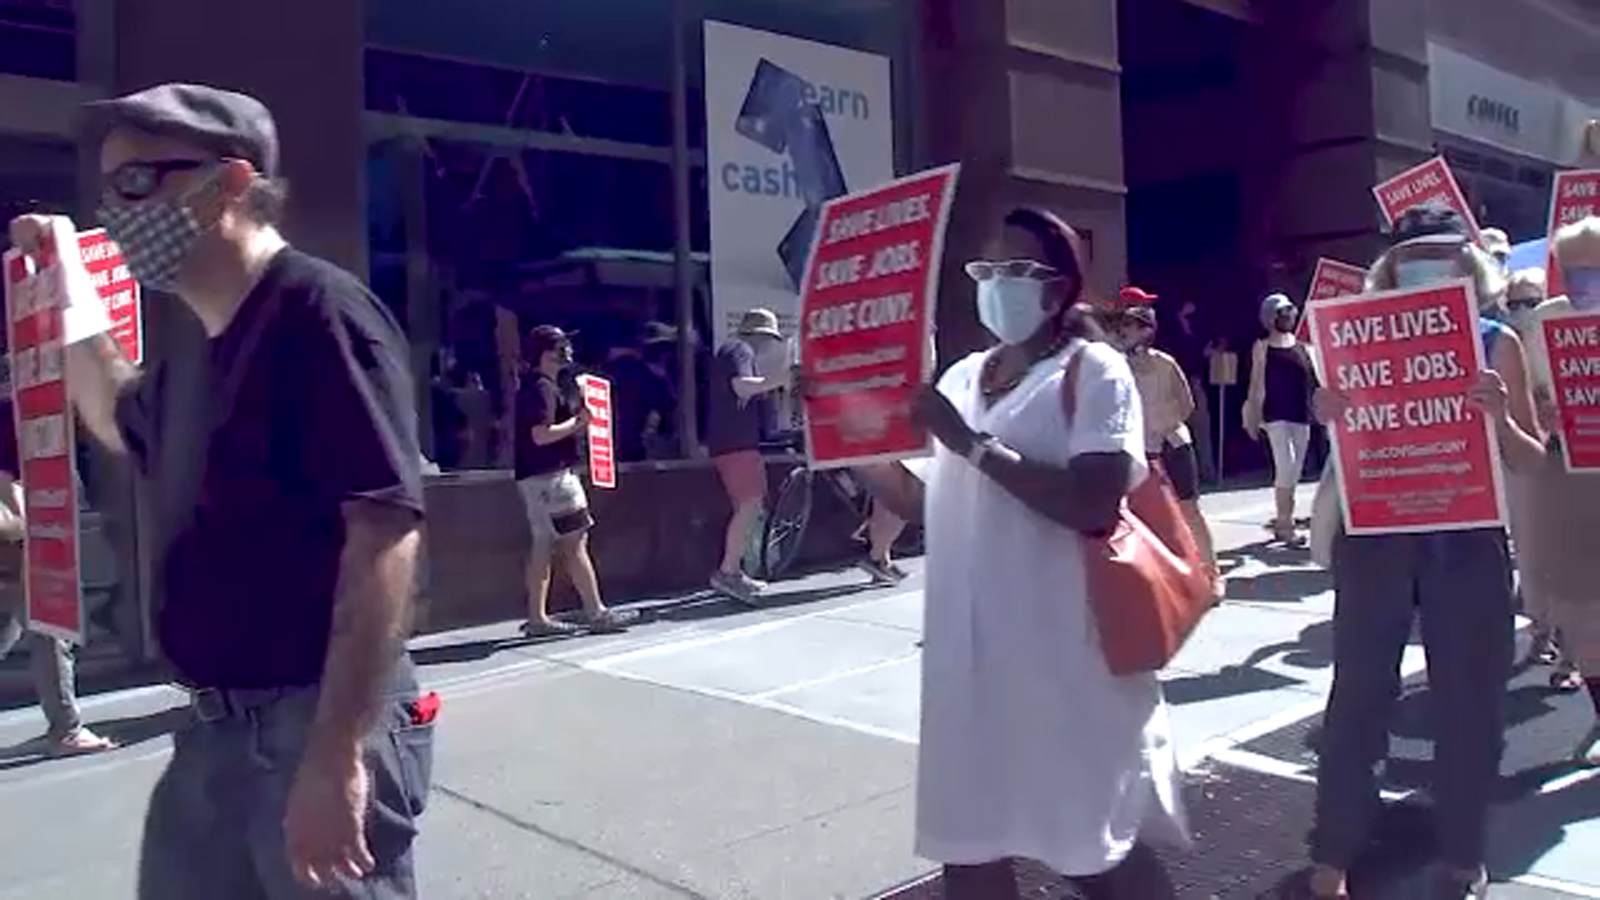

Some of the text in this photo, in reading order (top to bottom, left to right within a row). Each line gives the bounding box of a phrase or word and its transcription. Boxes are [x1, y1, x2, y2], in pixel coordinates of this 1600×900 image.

[800, 83, 869, 119] earn
[1467, 94, 1519, 135] COFFEE
[721, 162, 800, 198] cash
[1562, 182, 1597, 199] SAVE
[815, 253, 866, 291] SAVE
[808, 302, 856, 339] SAVE
[857, 291, 916, 330] CUNY.
[1329, 306, 1458, 348] SAVE LIVES.
[1554, 326, 1599, 348] SAVE
[1337, 351, 1465, 391] SAVE JOBS.
[1560, 357, 1600, 377] SAVE
[1344, 395, 1472, 433] SAVE CUNY.
